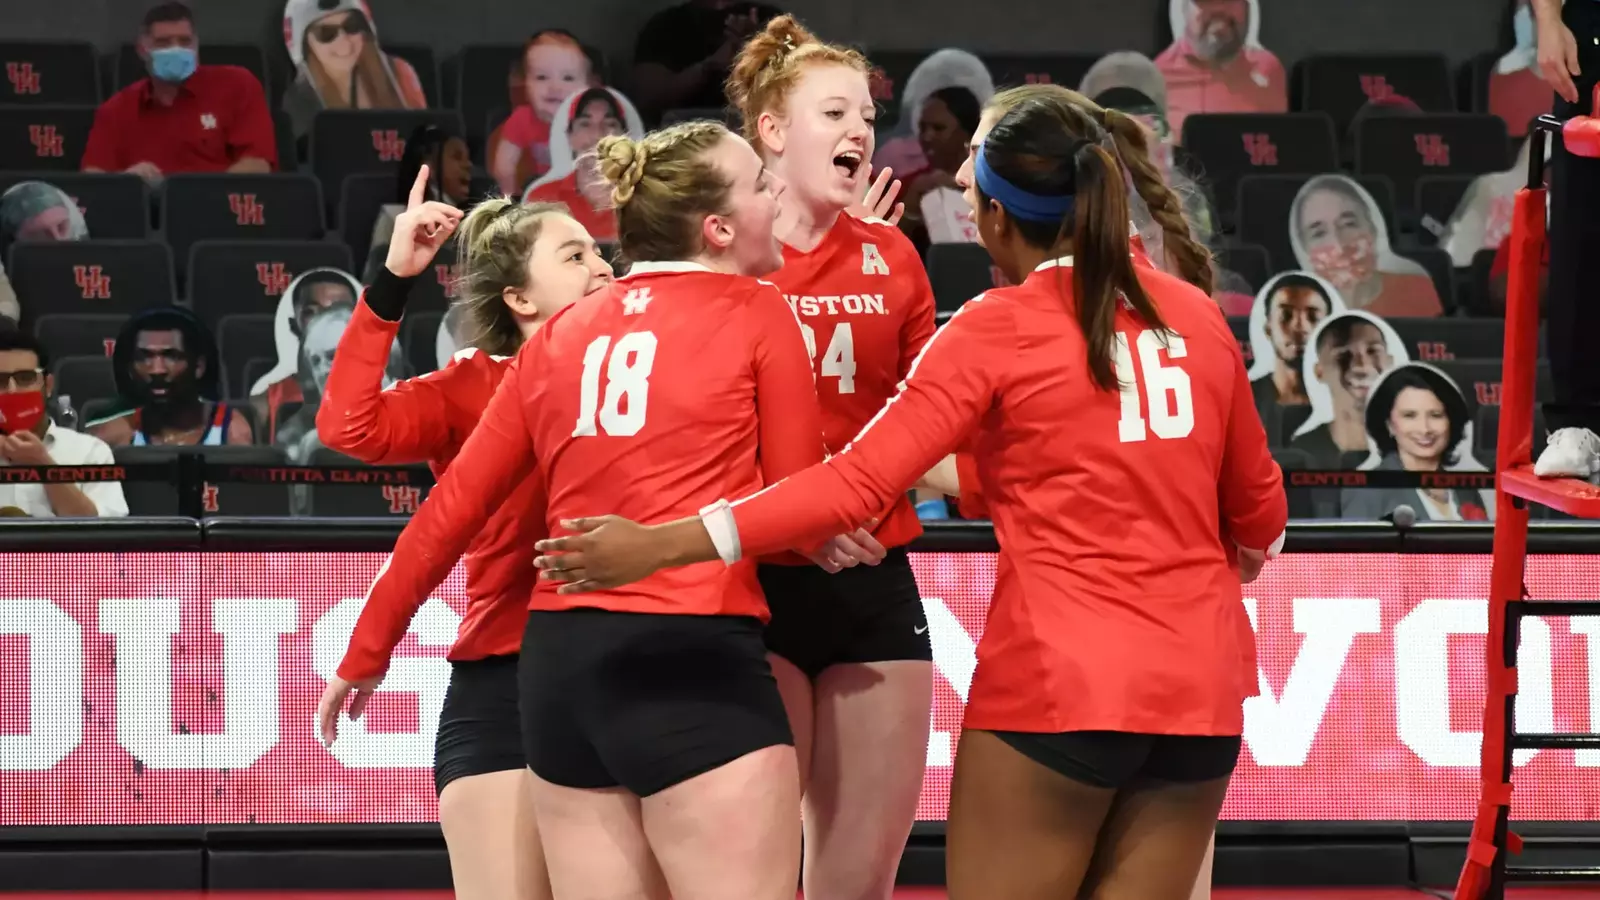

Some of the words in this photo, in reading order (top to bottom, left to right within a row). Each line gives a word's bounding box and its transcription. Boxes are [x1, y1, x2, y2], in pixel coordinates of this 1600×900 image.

[862, 243, 889, 275] A
[572, 331, 658, 437] 18
[1110, 328, 1195, 443] 16
[47, 466, 126, 481] CENTER
[228, 467, 325, 483] TITTA
[1290, 472, 1367, 487] CENTER
[1240, 598, 1600, 767] VO
